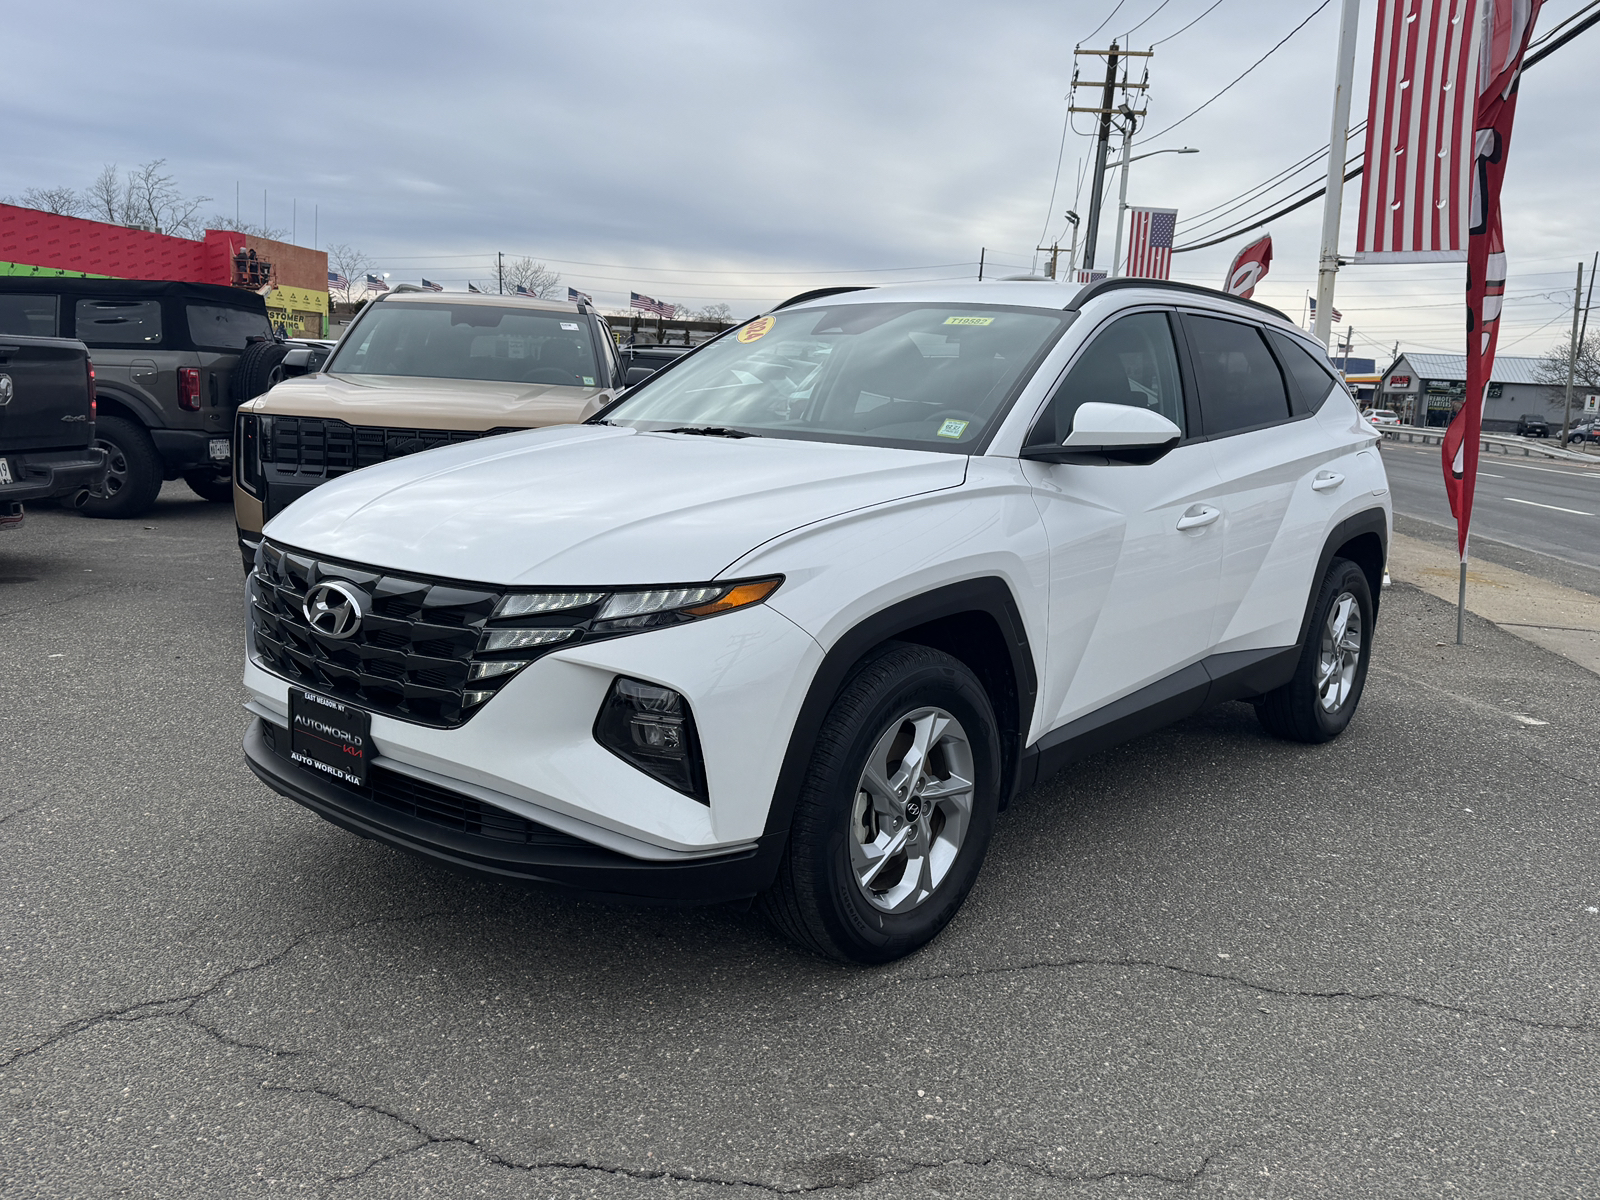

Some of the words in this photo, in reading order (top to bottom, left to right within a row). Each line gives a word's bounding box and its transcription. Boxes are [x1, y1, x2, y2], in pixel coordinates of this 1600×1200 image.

[269, 312, 304, 322] STOMER
[273, 320, 299, 329] RKING
[304, 692, 316, 702] EAST
[338, 704, 345, 712] NY
[294, 714, 363, 746] AUTOWORLD
[343, 744, 363, 758] KIA
[290, 752, 313, 766] AUTO
[313, 761, 343, 778] WORLD
[345, 773, 360, 786] KIA
